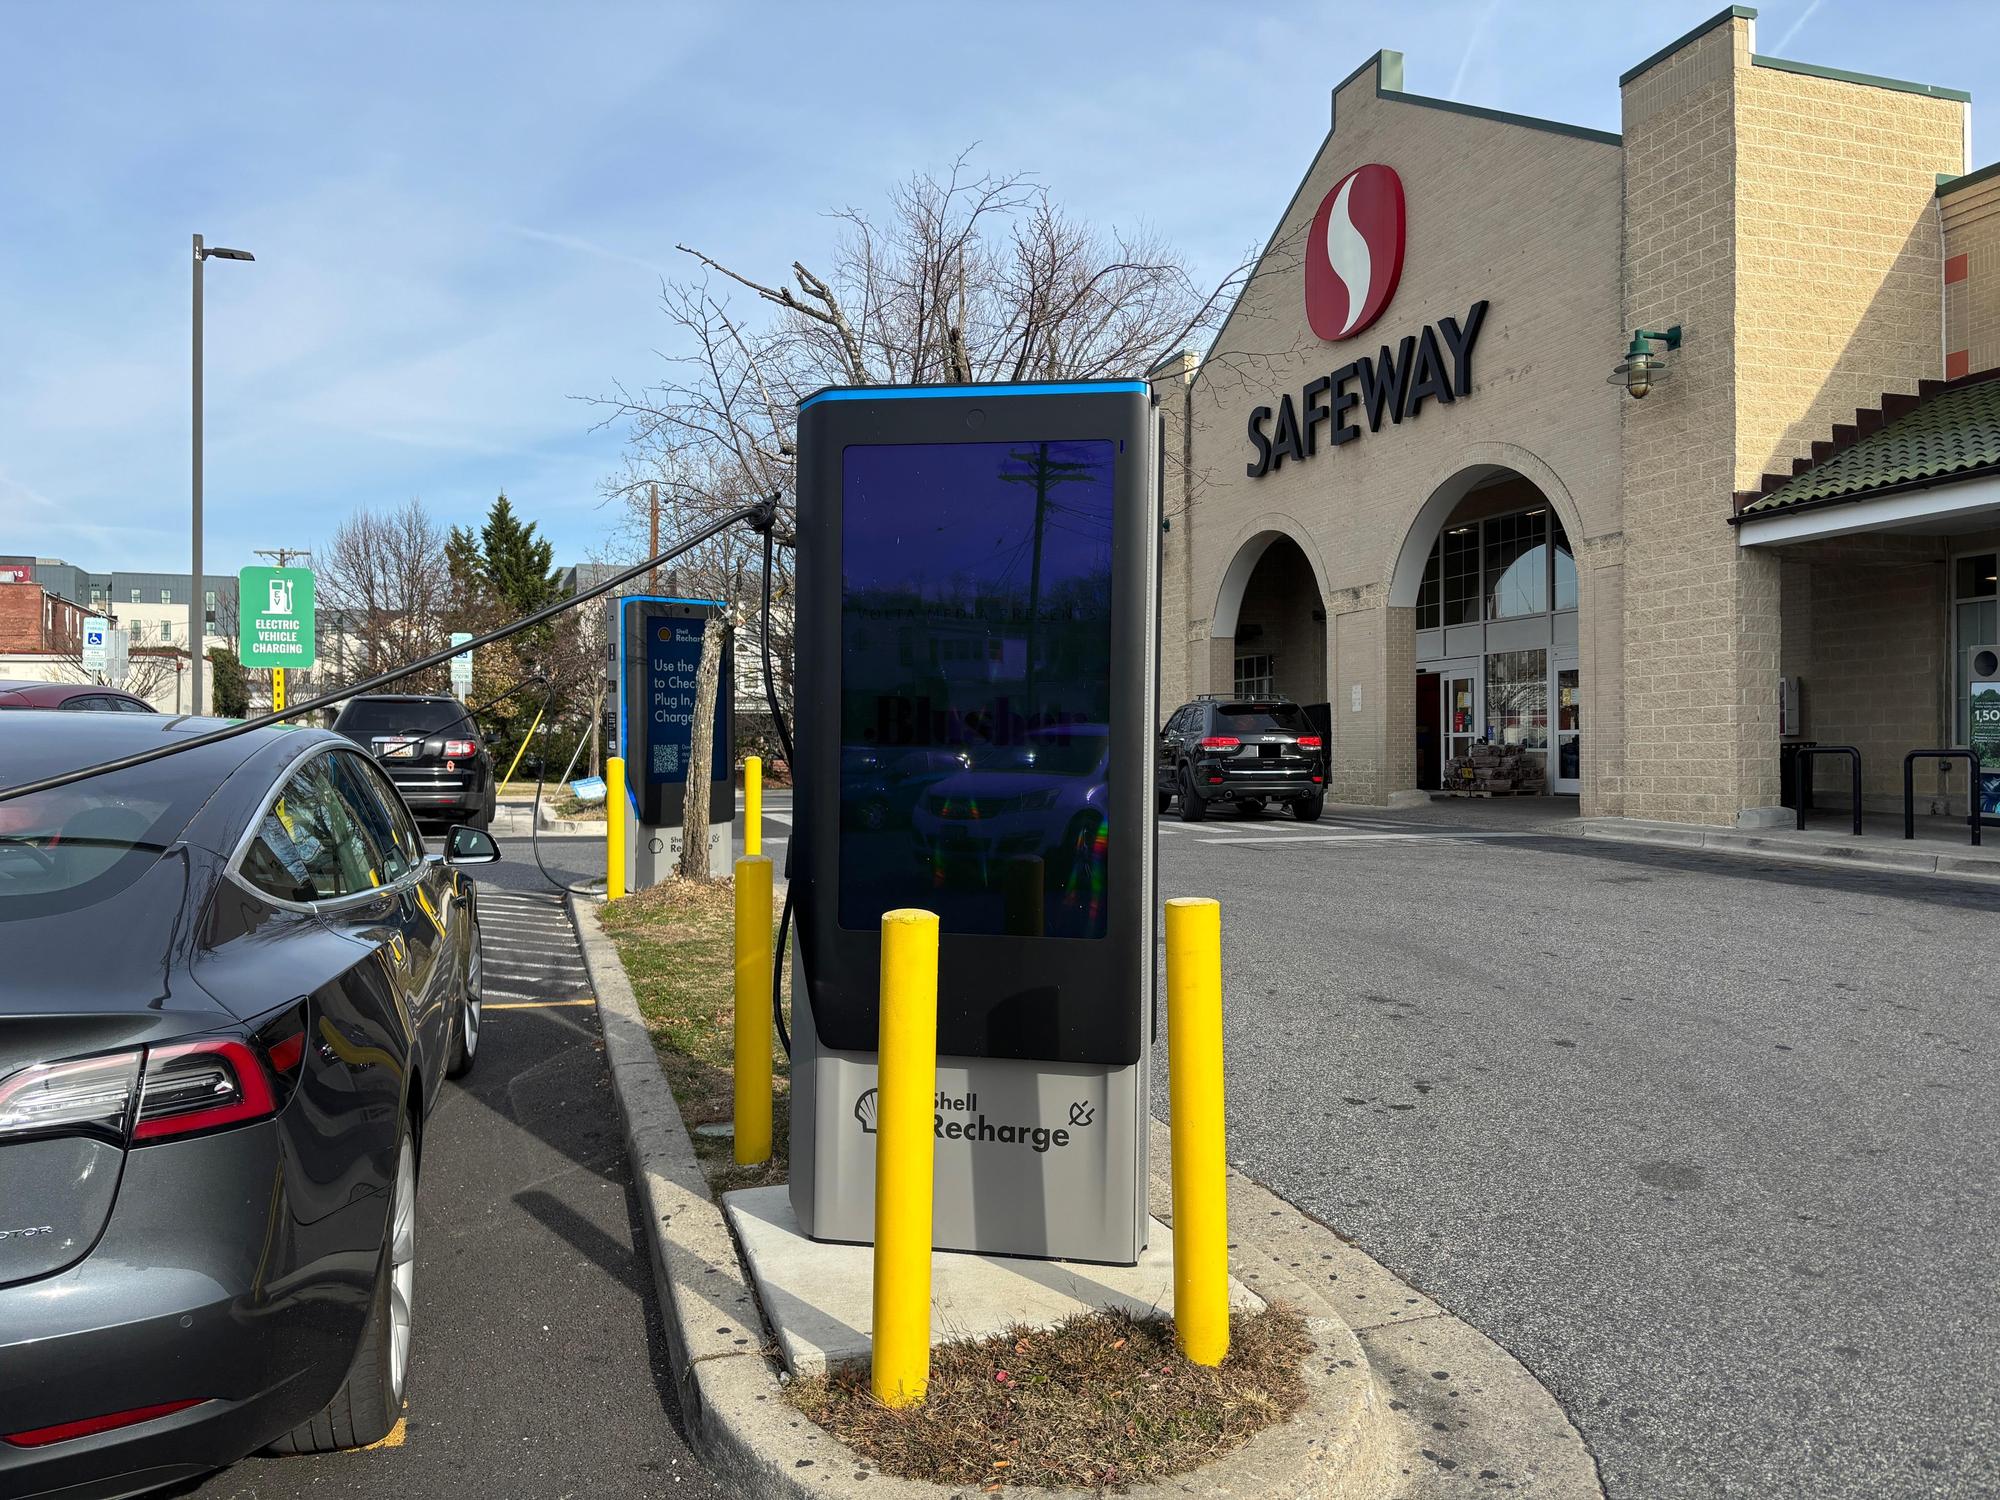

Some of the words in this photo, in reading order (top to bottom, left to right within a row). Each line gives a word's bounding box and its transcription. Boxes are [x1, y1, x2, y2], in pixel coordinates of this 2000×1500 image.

[1246, 299, 1490, 478] SAFEWAY
[273, 590, 281, 606] EV
[255, 619, 300, 630] ELECTRIC
[258, 631, 298, 642] VEHICLE
[675, 634, 703, 643] Rechar
[252, 642, 303, 654] CHARGING
[654, 658, 674, 672] Use
[677, 658, 694, 672] the
[654, 677, 666, 689] to
[668, 676, 698, 689] Chec
[654, 691, 678, 709] Plug
[680, 692, 694, 708] In,
[654, 709, 695, 726] Charge
[1974, 709, 2000, 723] 1,50
[670, 836, 682, 844] She
[934, 1114, 1070, 1153] Recharge
